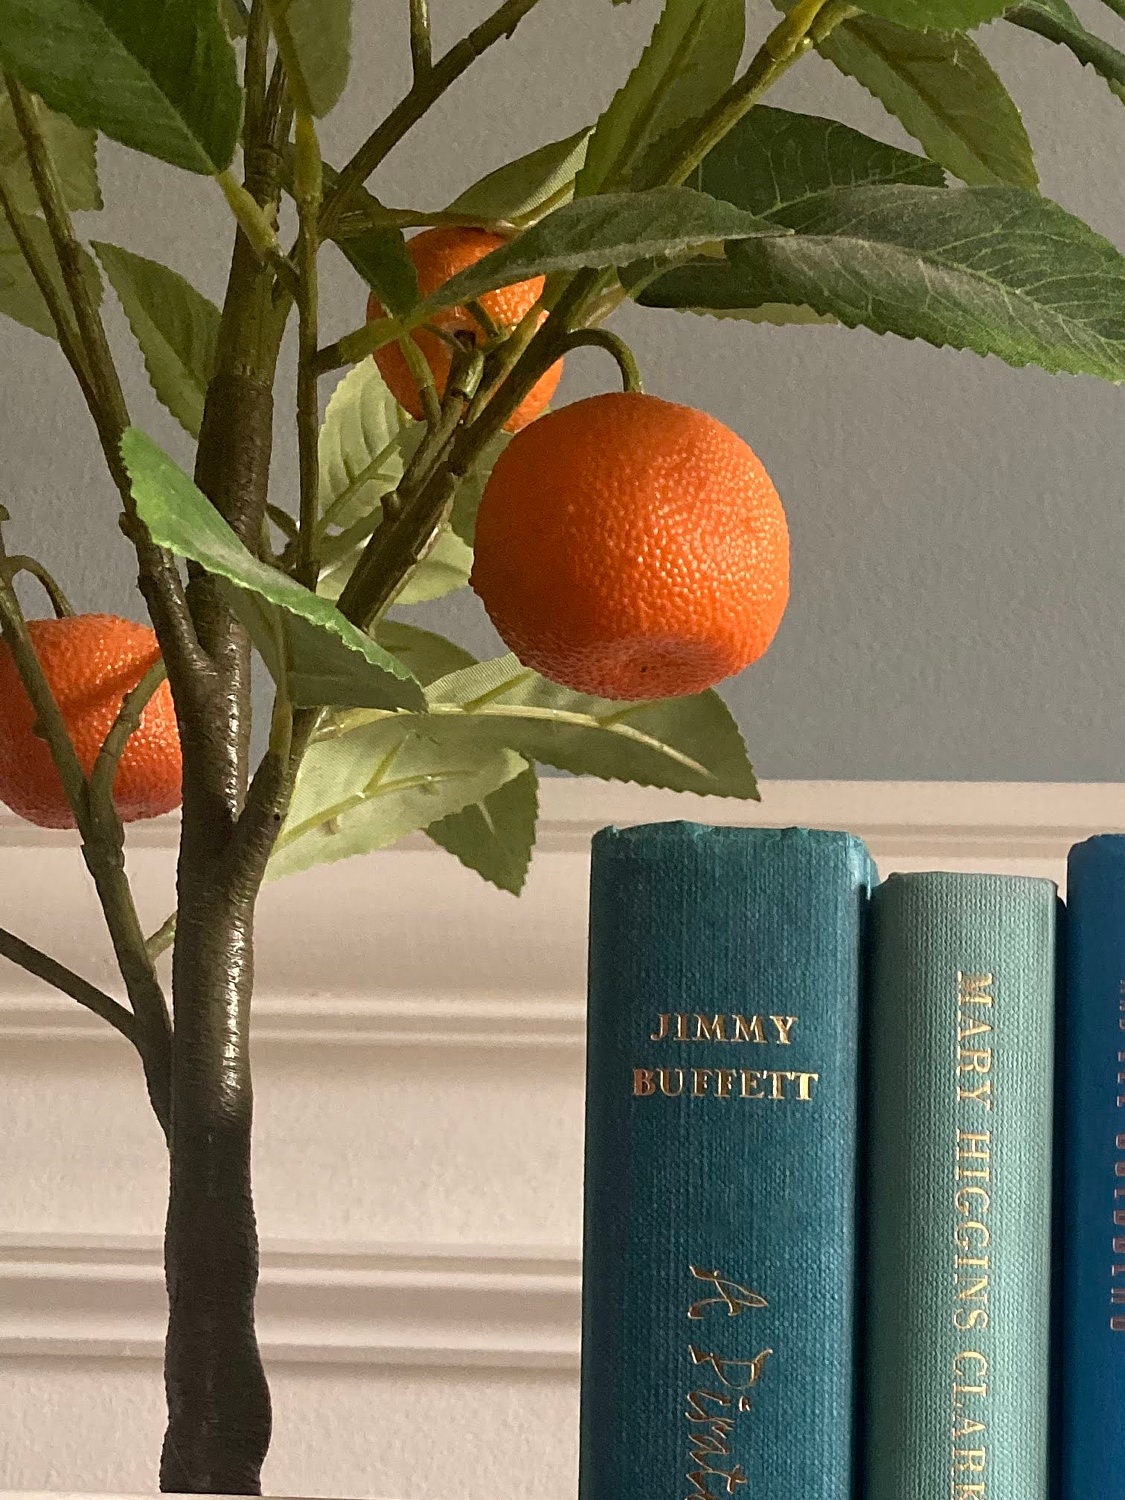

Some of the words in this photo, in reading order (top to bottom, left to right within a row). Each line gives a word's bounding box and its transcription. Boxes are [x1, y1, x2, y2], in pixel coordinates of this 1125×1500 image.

[650, 1012, 798, 1045] JIMMY
[954, 970, 993, 1112] MARY
[632, 1068, 819, 1101] BUFFETT
[952, 1127, 991, 1332] HIGGINS
[687, 1264, 769, 1320] A
